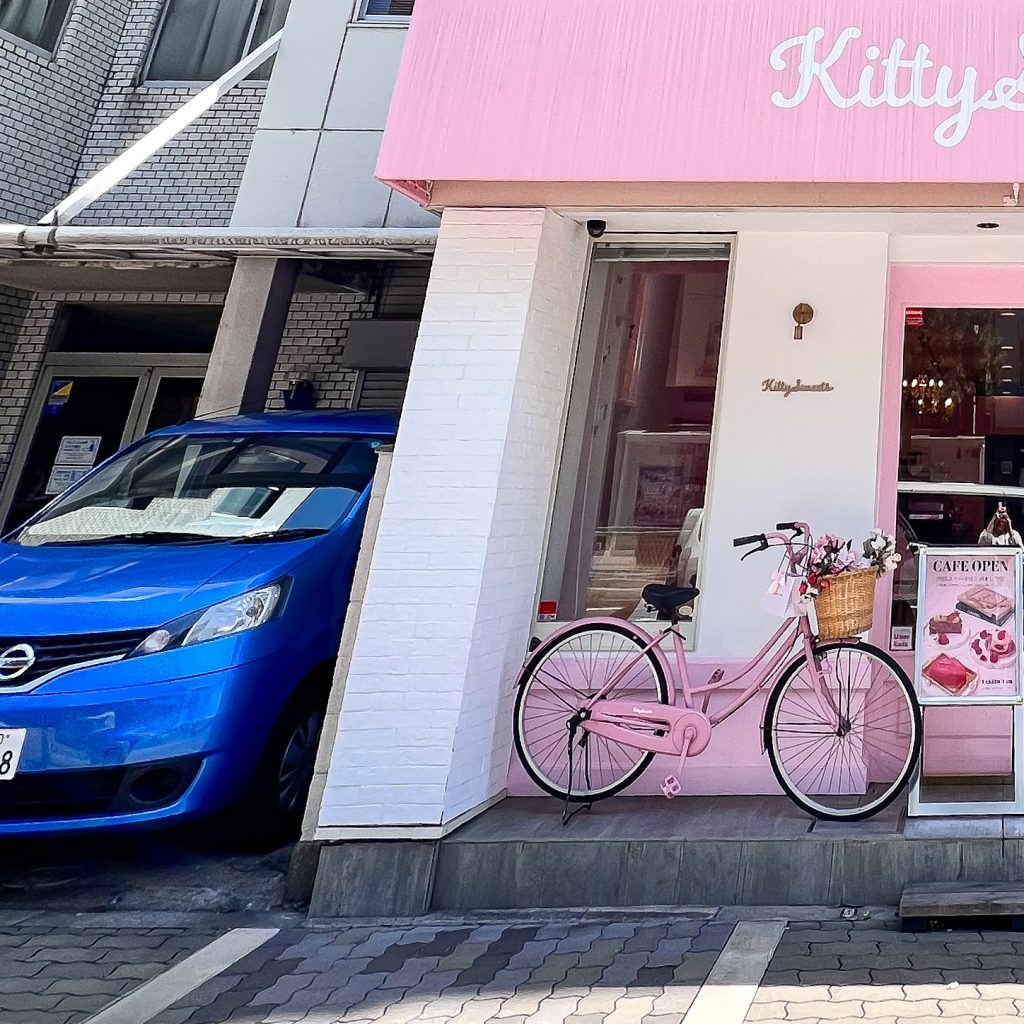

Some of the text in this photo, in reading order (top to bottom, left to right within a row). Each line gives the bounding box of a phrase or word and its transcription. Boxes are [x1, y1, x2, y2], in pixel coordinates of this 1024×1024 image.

[770, 26, 985, 148] Kitty
[933, 560, 1009, 572] CAFE OPEN
